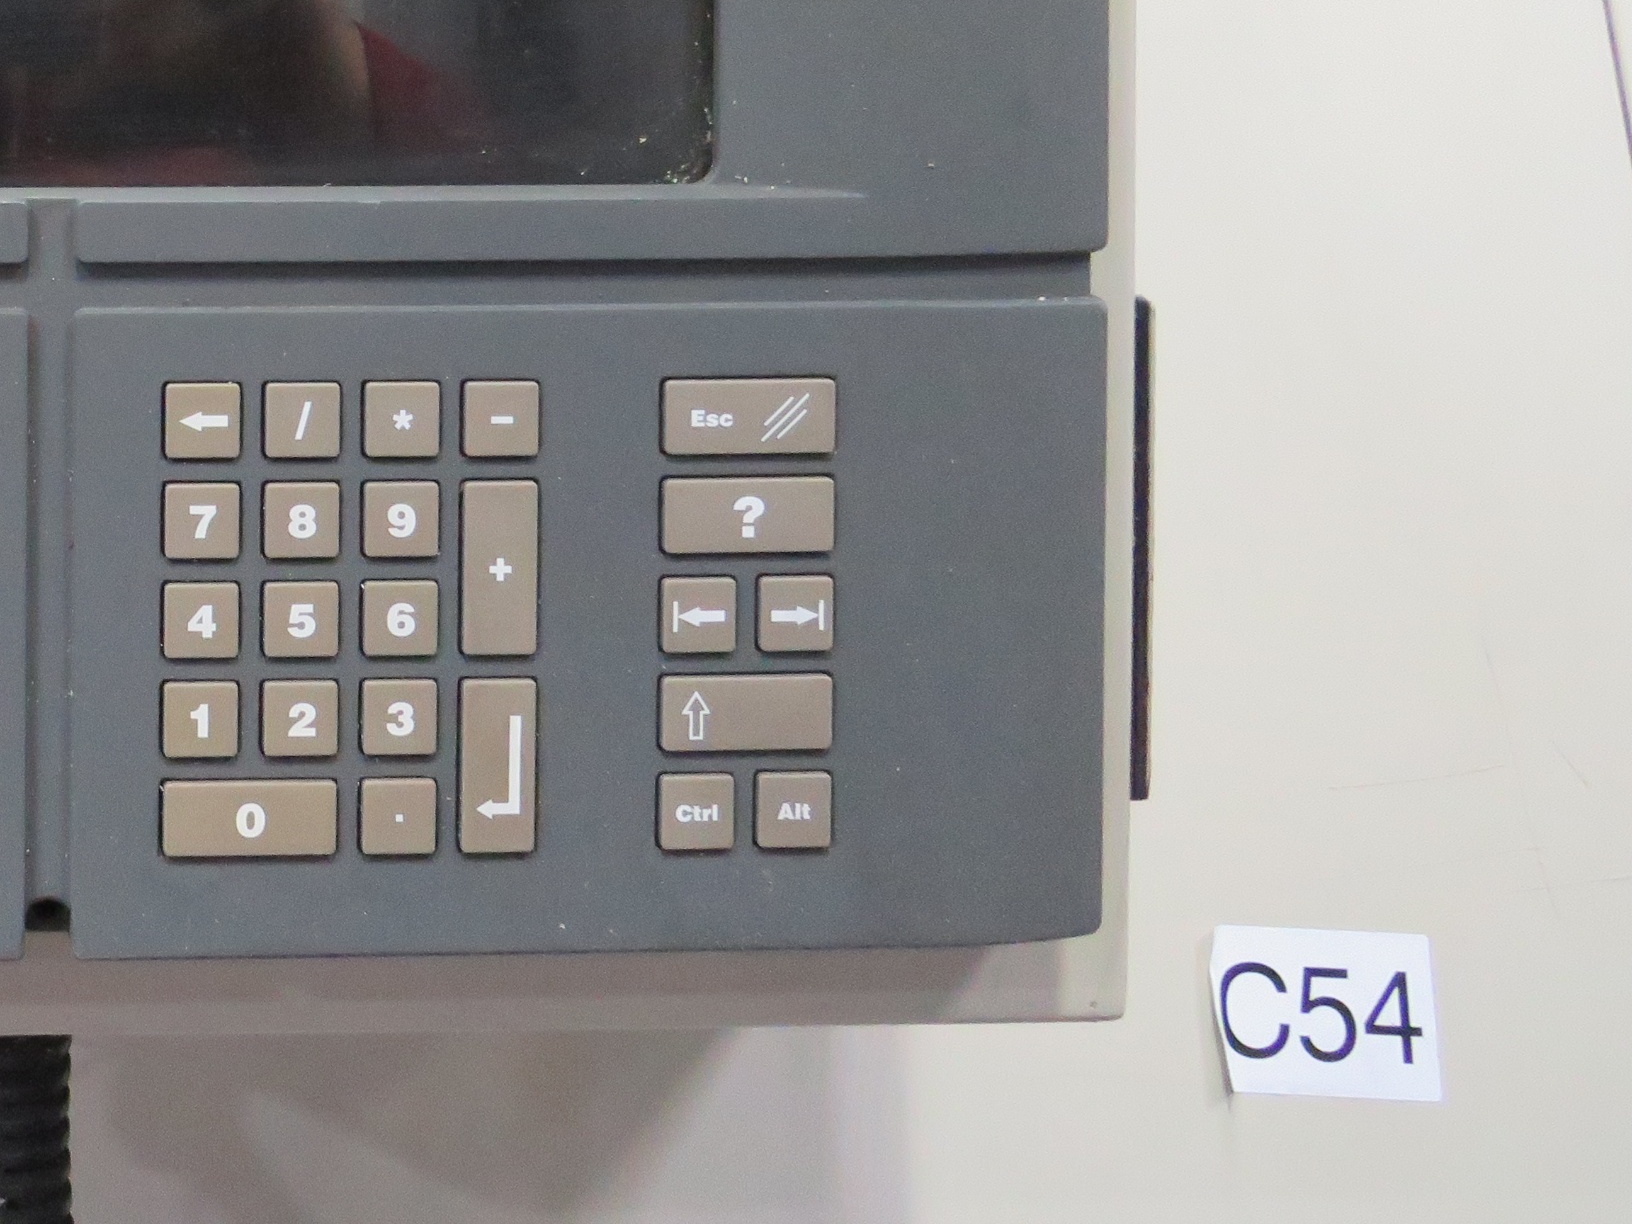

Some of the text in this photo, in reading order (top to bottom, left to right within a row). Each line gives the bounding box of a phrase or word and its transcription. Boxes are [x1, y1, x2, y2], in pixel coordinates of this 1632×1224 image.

[690, 409, 734, 428] Esc
[189, 504, 217, 539] 7
[287, 504, 317, 539] 8
[387, 503, 417, 538] 9
[733, 495, 765, 538] ?
[187, 604, 217, 639] 4
[287, 603, 316, 639] 5
[386, 602, 416, 637] 6
[190, 703, 209, 738] 1
[287, 702, 317, 737] 2
[386, 701, 415, 737] 3
[235, 802, 266, 838] 0
[675, 804, 718, 823] Ctrl
[777, 802, 811, 820] Alt
[1220, 961, 1424, 1065] C54
